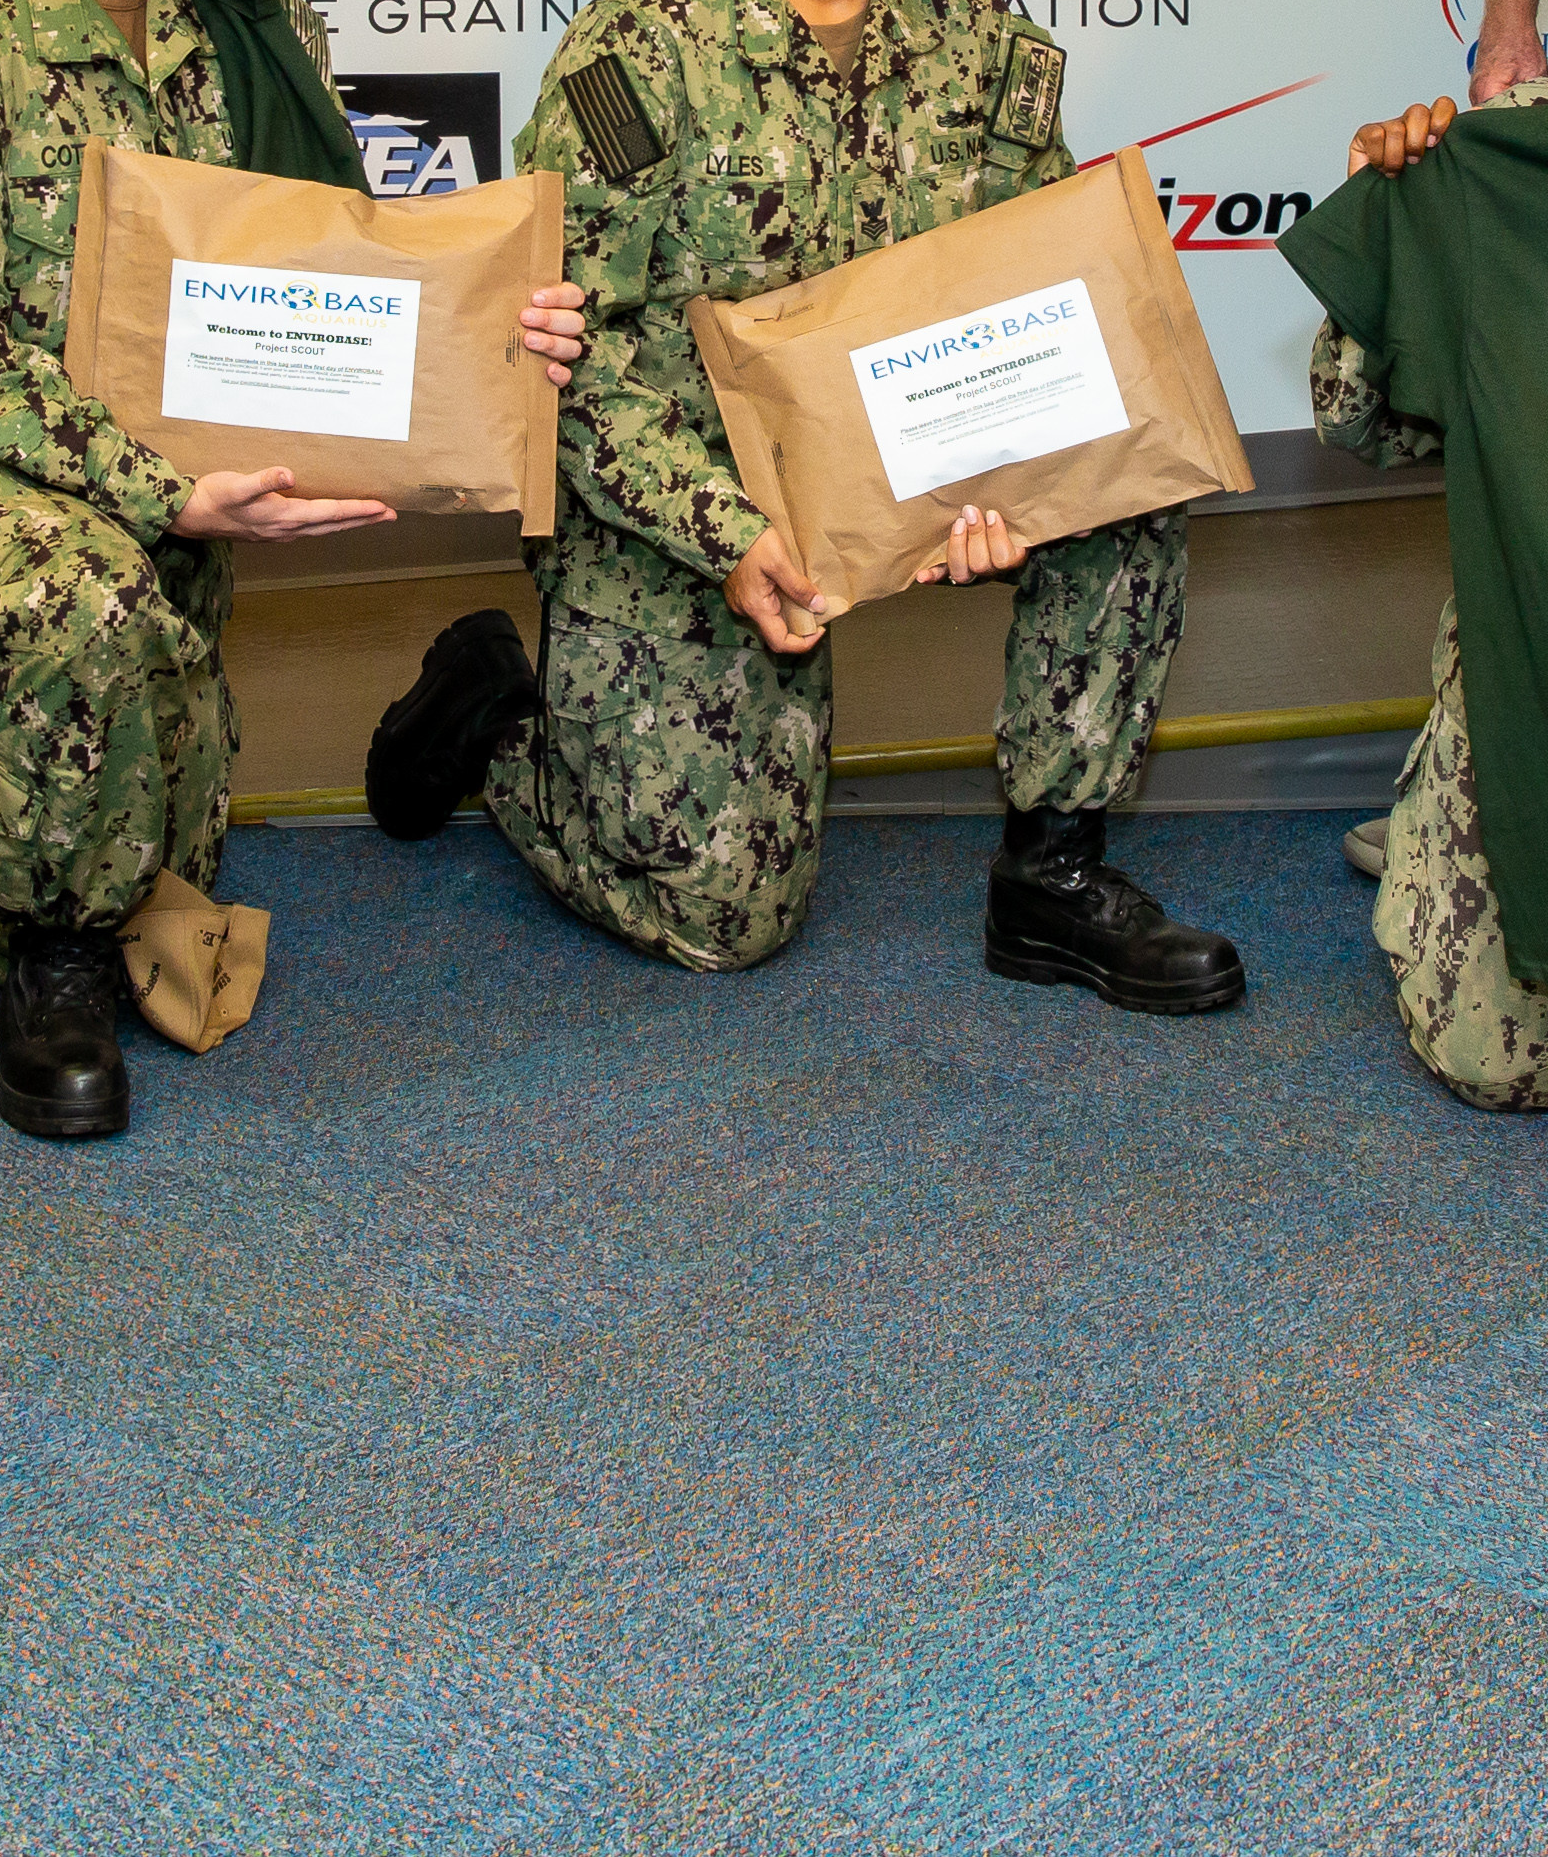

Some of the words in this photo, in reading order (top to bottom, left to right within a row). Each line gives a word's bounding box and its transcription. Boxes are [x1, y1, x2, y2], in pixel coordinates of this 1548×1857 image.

[706, 152, 764, 178] LYLES
[1157, 177, 1312, 251] izon
[207, 324, 265, 339] Welcome
[270, 329, 283, 339] to
[286, 331, 373, 346] ENVIROBASE!
[255, 342, 288, 355] Project
[291, 345, 325, 356] SCOUT
[905, 380, 962, 402] Welcome
[964, 375, 977, 386] to
[979, 346, 1062, 379] ENVIROBASE!
[956, 385, 989, 402] Project
[990, 373, 1022, 390] SCOUT
